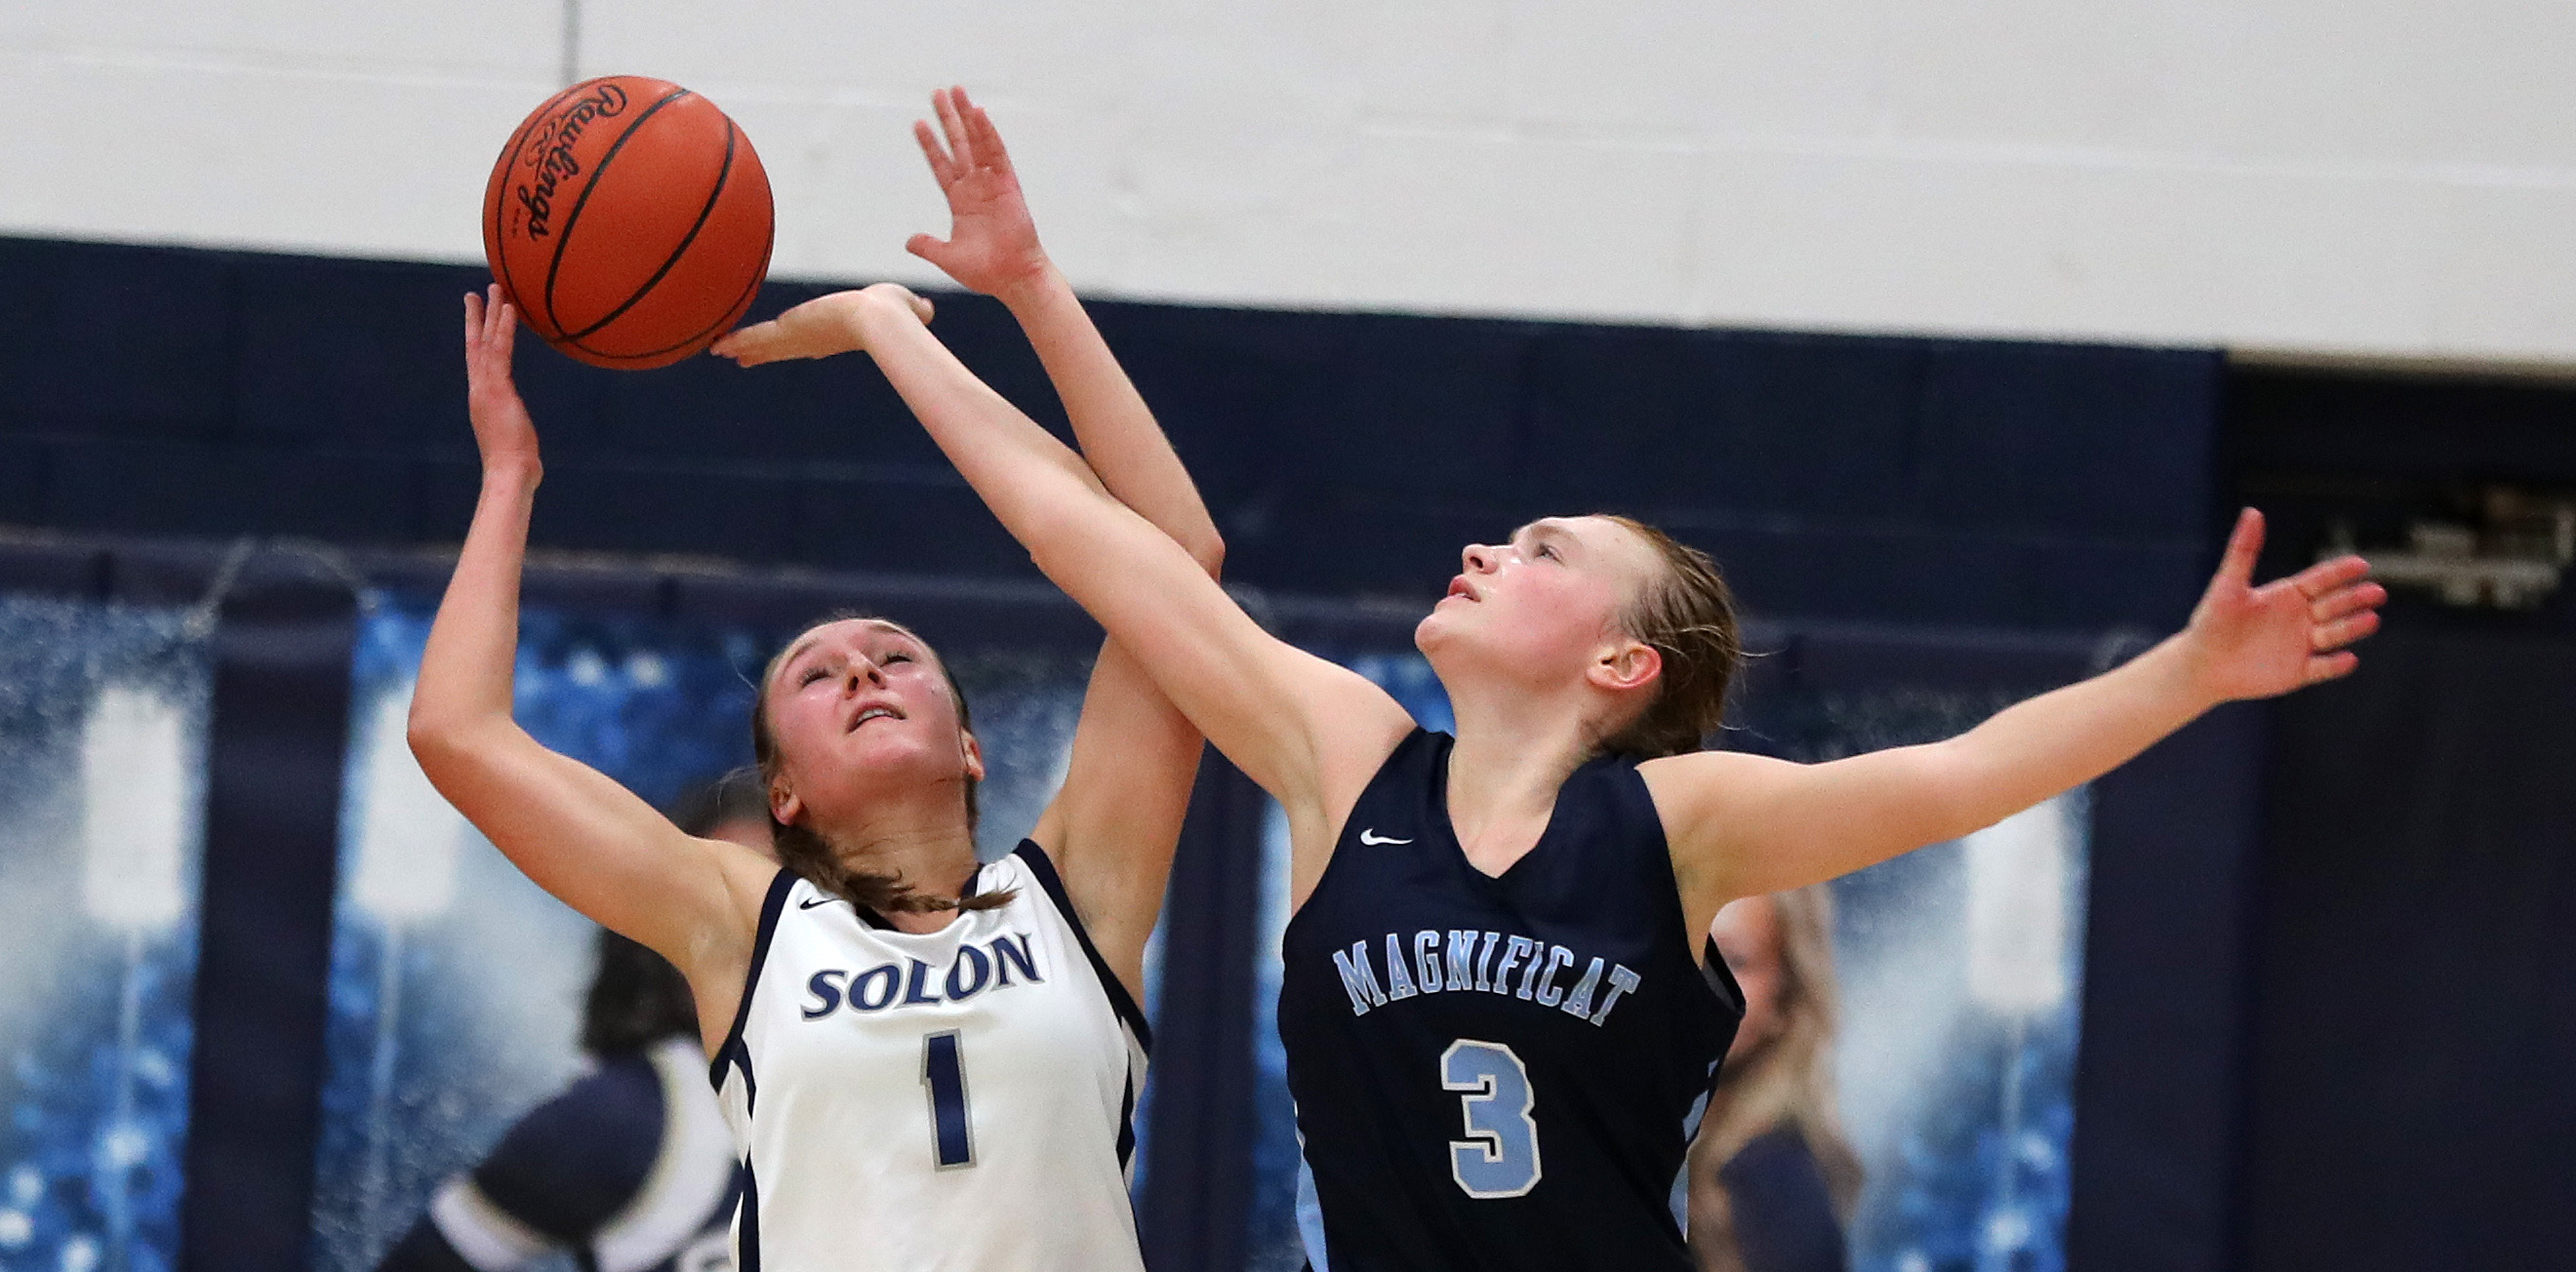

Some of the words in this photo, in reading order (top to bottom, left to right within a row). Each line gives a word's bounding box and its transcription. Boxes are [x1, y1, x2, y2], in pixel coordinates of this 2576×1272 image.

[517, 84, 627, 241] Rawlings
[800, 933, 1046, 1022] SOLON
[1332, 929, 1642, 1027] MAGNIFICAT
[919, 1027, 977, 1173] 1
[1440, 1038, 1542, 1199] 3
